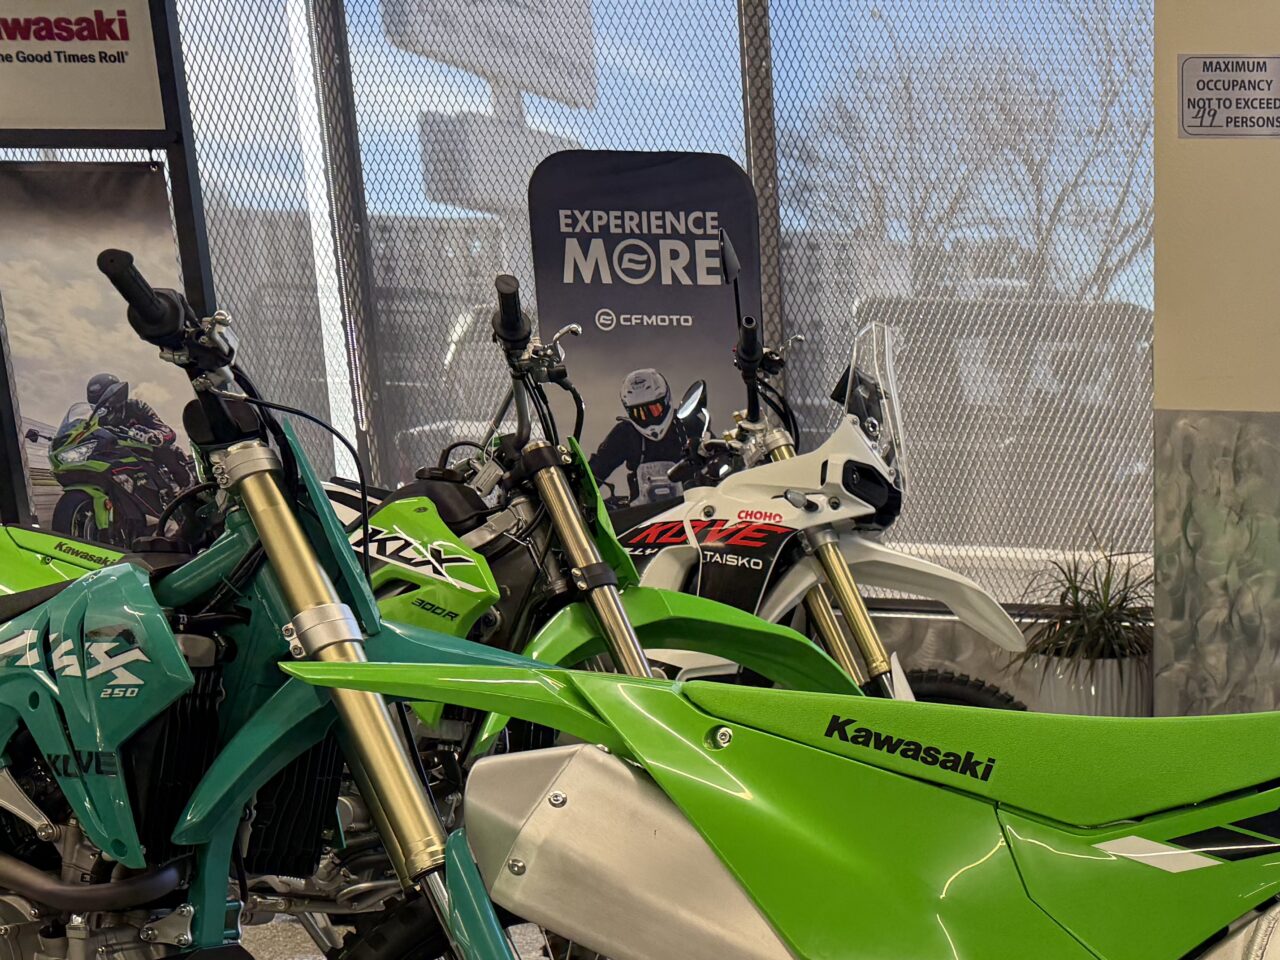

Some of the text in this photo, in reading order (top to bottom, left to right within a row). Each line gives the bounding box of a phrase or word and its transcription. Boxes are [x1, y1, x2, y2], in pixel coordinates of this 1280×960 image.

[0, 9, 129, 41] wasaki
[16, 50, 52, 63] Good
[54, 50, 95, 63] Times
[1202, 61, 1267, 72] MAXIMUM
[1196, 80, 1274, 91] OCCUPANCY
[1187, 98, 1214, 110] NOT
[1215, 98, 1232, 110] TO
[558, 209, 719, 235] EXPERIENCE
[563, 237, 722, 286] MORE
[619, 314, 693, 326] CFMOTO
[737, 509, 783, 523] CHOHO
[54, 541, 117, 566] Kawasaki
[704, 551, 763, 570] TAISKO
[411, 597, 460, 621] 300R
[100, 687, 139, 698] 250
[824, 714, 997, 783] Kawasaki
